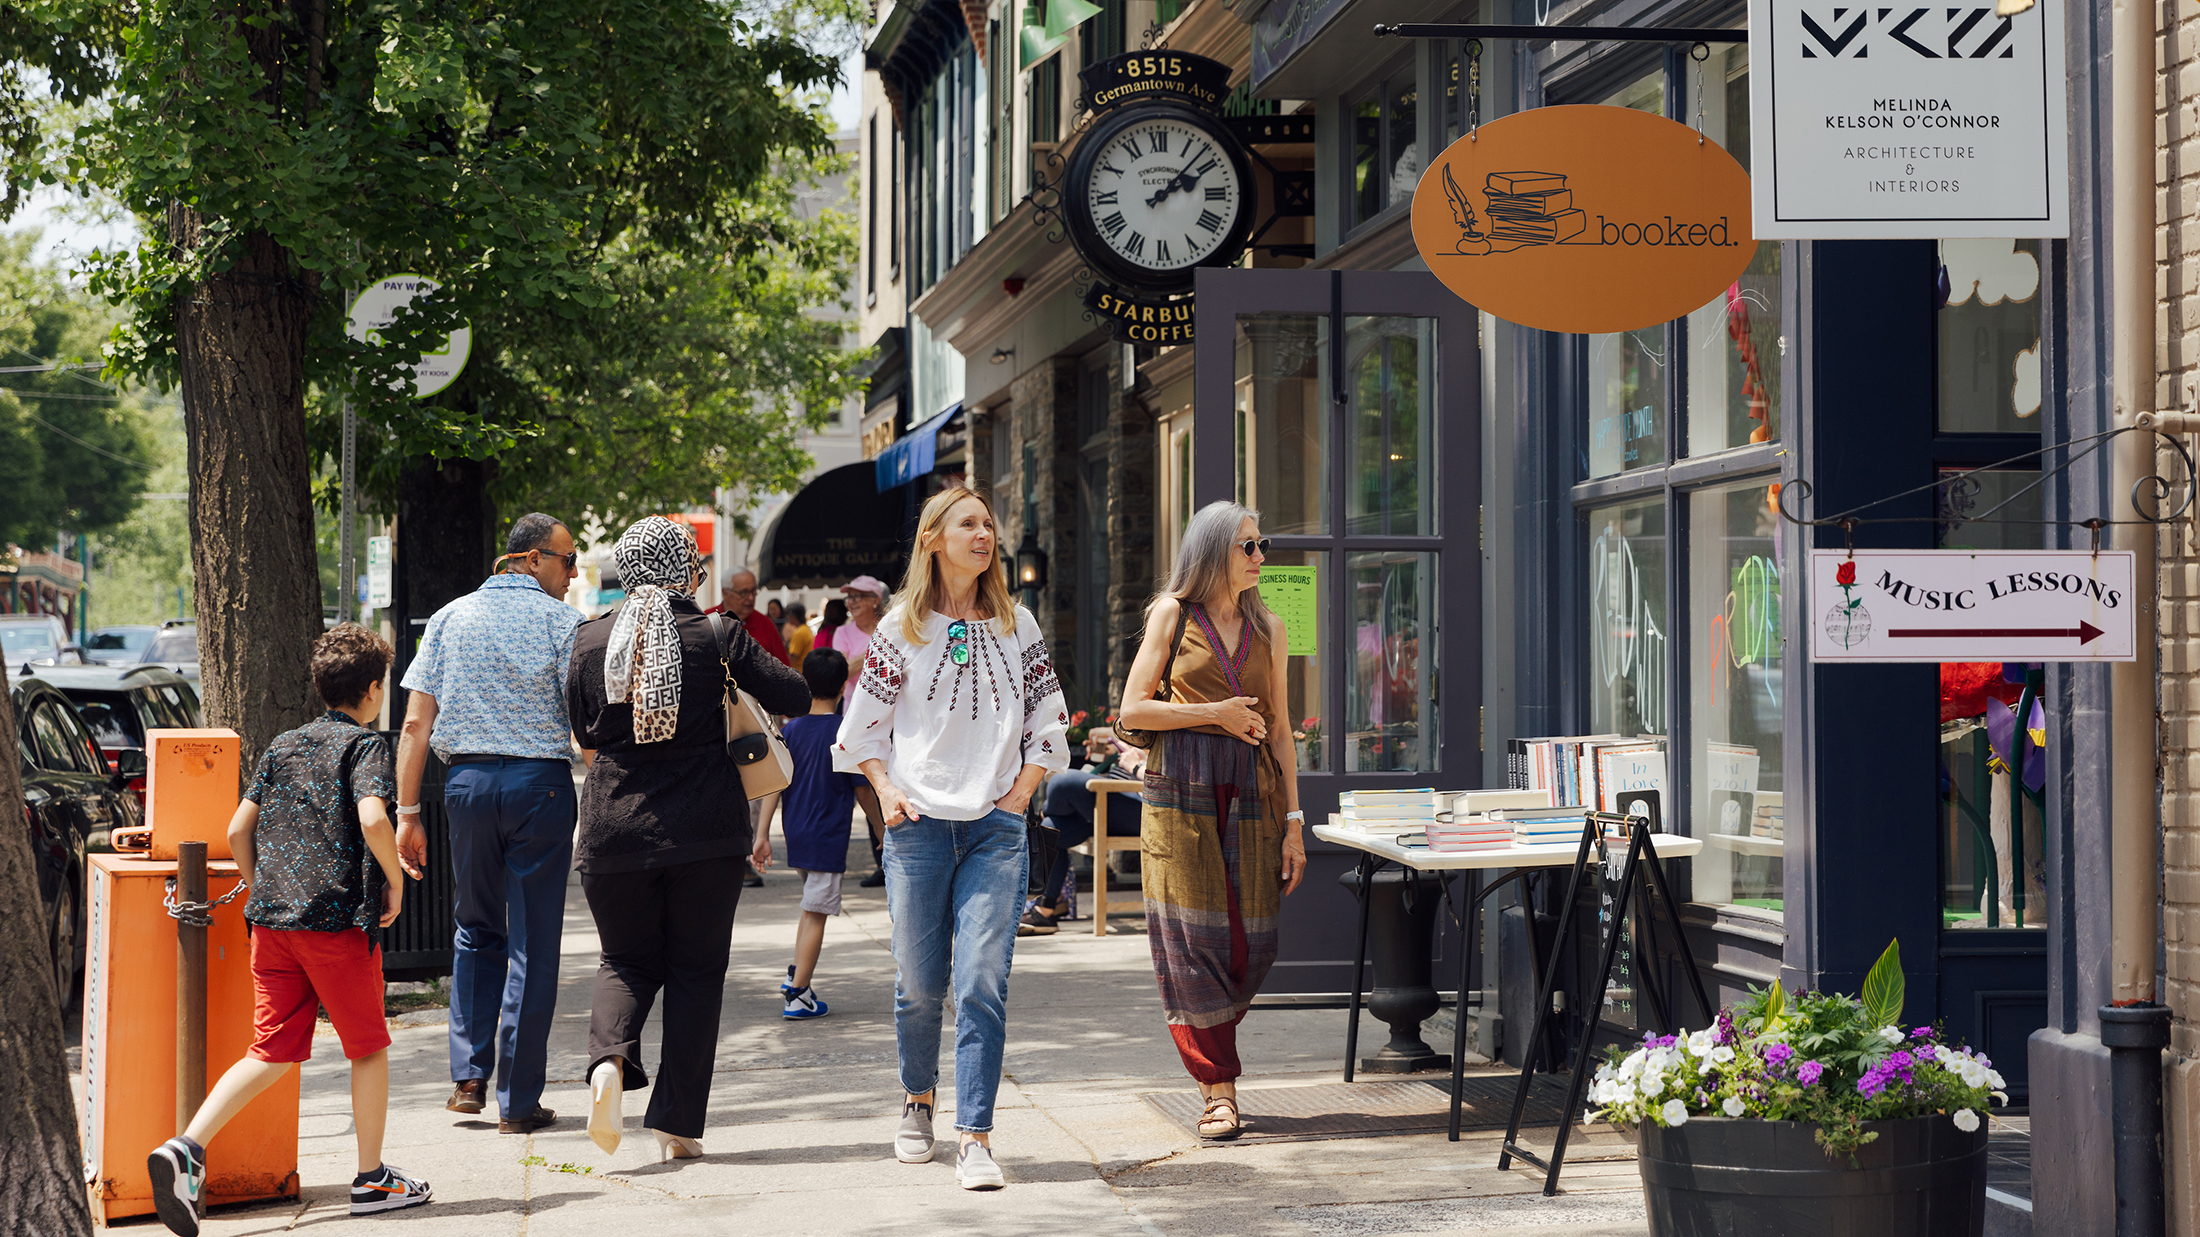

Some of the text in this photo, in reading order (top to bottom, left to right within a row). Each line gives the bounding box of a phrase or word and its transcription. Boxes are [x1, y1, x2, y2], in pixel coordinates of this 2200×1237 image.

[1126, 57, 1182, 78] 8515
[1094, 78, 1185, 105] Germantown
[1188, 83, 1216, 103] Ave
[1873, 98, 1952, 112] MELINDA
[1825, 115, 2001, 129] KELSON O'CONNOR
[1843, 146, 1976, 159] ARCHITECTURE
[1138, 166, 1183, 178] SYNCHRONOM
[1905, 163, 1916, 176] &
[1142, 178, 1179, 186] ELECTR
[1868, 180, 1961, 193] INTERIORS
[1596, 215, 1739, 247] booked.
[383, 282, 404, 291] PAY
[1097, 294, 1195, 323] STARBU
[1128, 323, 1195, 341] COFFE
[826, 537, 858, 550] THE
[775, 552, 841, 567] ANTIQUE
[1288, 574, 1311, 586] HOURS
[1874, 569, 2122, 612] MUSIC LESSONS
[1711, 554, 1778, 708] PRIDE
[1632, 762, 1647, 775] In
[1623, 778, 1660, 791] Love
